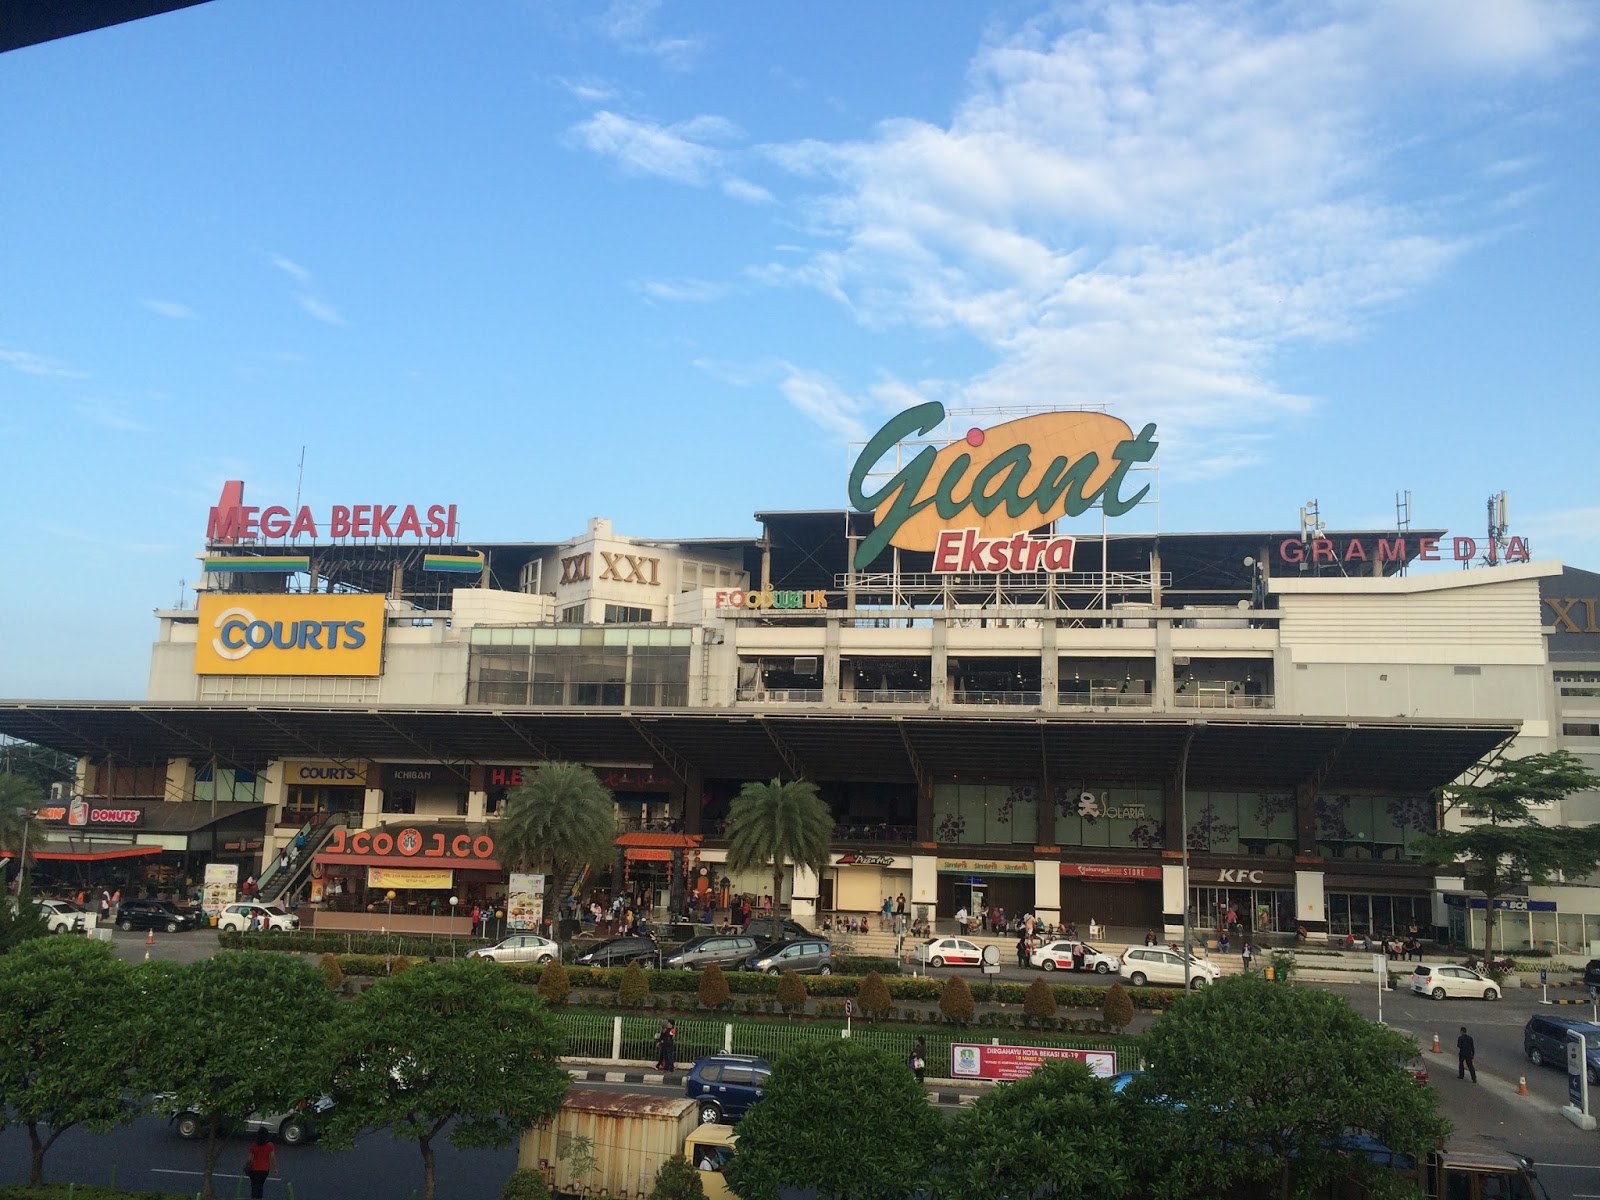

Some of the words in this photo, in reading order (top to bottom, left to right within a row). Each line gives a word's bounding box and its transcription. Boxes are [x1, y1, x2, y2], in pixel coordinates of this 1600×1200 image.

[849, 401, 1159, 569] Giant
[206, 505, 318, 538] MEGA
[330, 504, 457, 538] BEKASI
[934, 529, 1074, 572] Ekstra
[1280, 536, 1530, 563] GRAMEDIA
[560, 551, 591, 585] XXI
[599, 551, 661, 586] XXI
[220, 620, 366, 650] COURTS
[300, 767, 355, 780] COURTS
[394, 770, 431, 780] ICHIBAN
[91, 809, 138, 823] DONUTS
[326, 830, 394, 855] J.CO
[424, 833, 494, 858] J.CO
[855, 855, 876, 864] Pizza
[876, 856, 892, 865] Hut
[1123, 868, 1145, 877] STORE
[1217, 869, 1263, 883] KFC
[1510, 901, 1528, 910] BCA
[987, 1047, 1021, 1056] DIRGAHAYU
[1040, 1050, 1060, 1058] BEKASI
